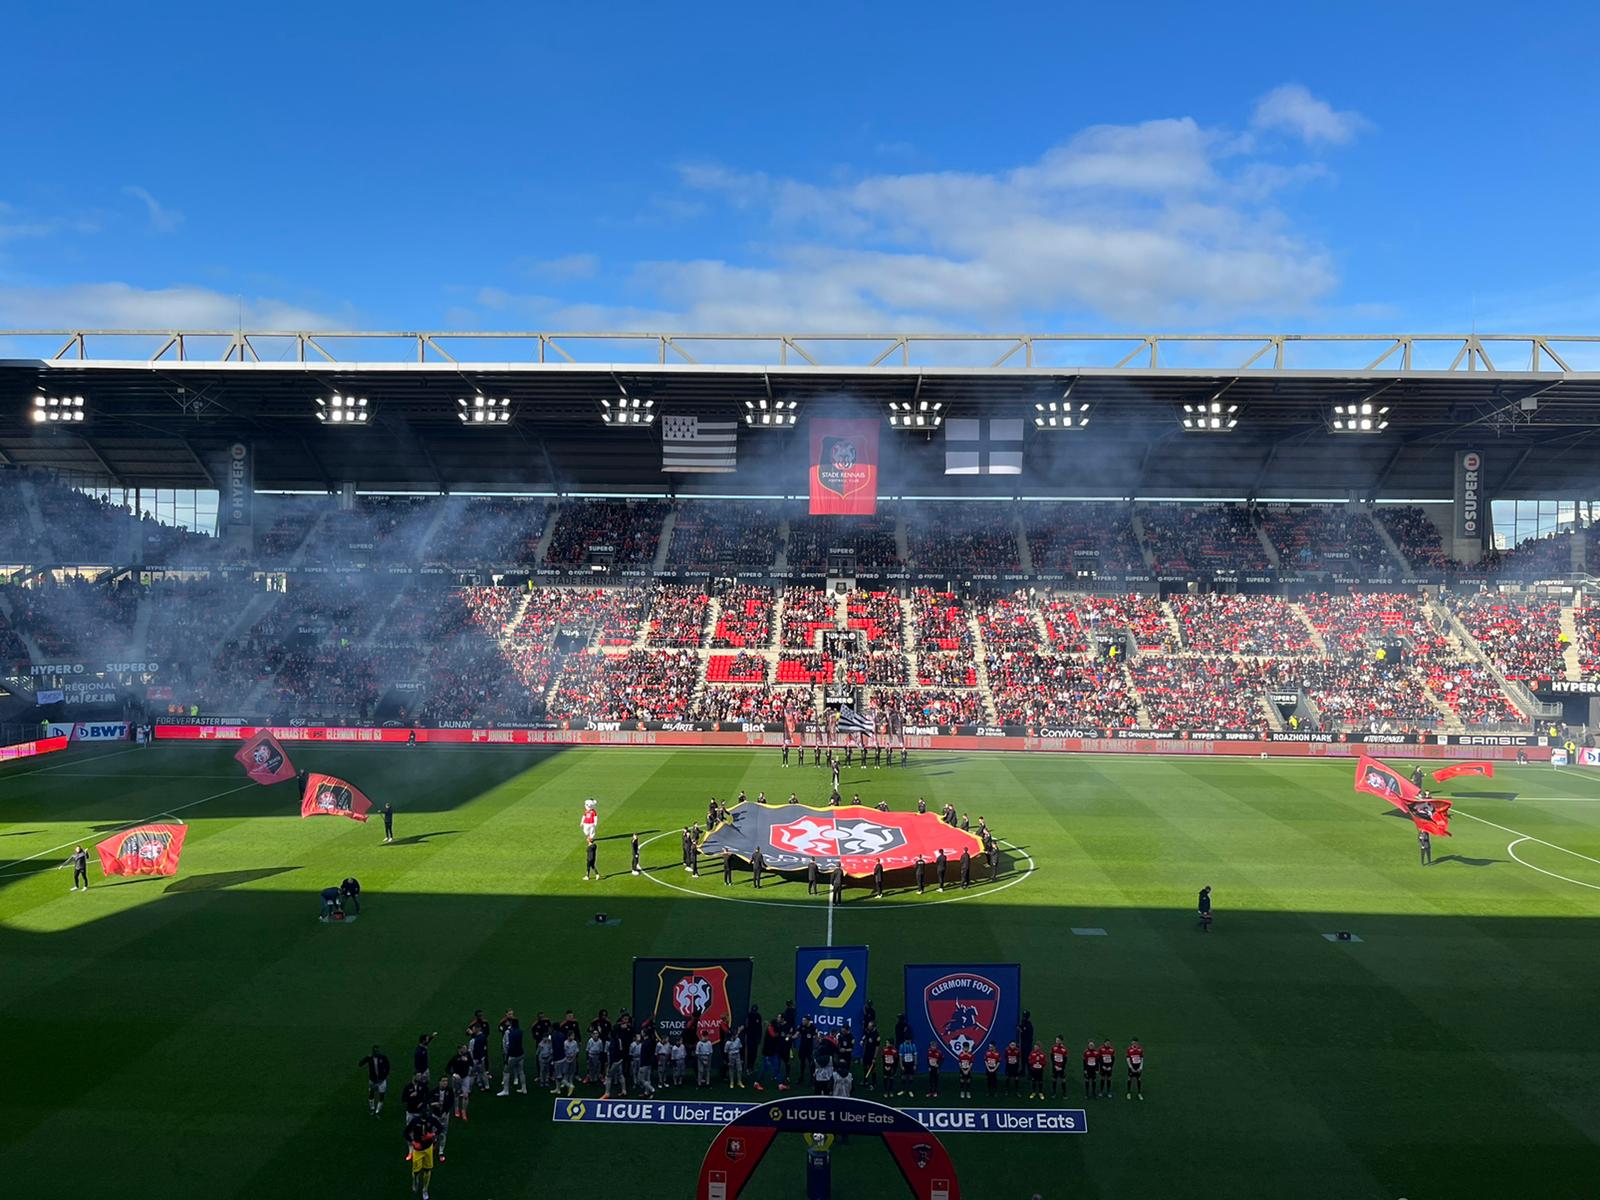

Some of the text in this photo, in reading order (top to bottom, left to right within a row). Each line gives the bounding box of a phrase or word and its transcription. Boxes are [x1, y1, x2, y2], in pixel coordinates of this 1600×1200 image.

[233, 461, 244, 507] HYPER
[1465, 472, 1478, 520] SUPER
[545, 576, 576, 585] STADE
[580, 577, 623, 585] RENNAIS
[31, 664, 71, 675] HYPER
[106, 663, 146, 672] SUPER
[1552, 682, 1596, 692] HYPER
[91, 726, 126, 737] BWT
[742, 723, 765, 732] Blot
[1040, 729, 1083, 737] Convivio
[931, 978, 994, 996] CLERMONT FOOT
[660, 1020, 686, 1029] STADE
[846, 1018, 852, 1027] 1
[596, 1103, 653, 1119] LIGUE
[658, 1105, 665, 1119] 1
[673, 1106, 710, 1120] Uber
[786, 1109, 894, 1124] LIGUE 1 Uber Eats
[918, 1112, 1075, 1128] LIGUE 1 Uber Eats
